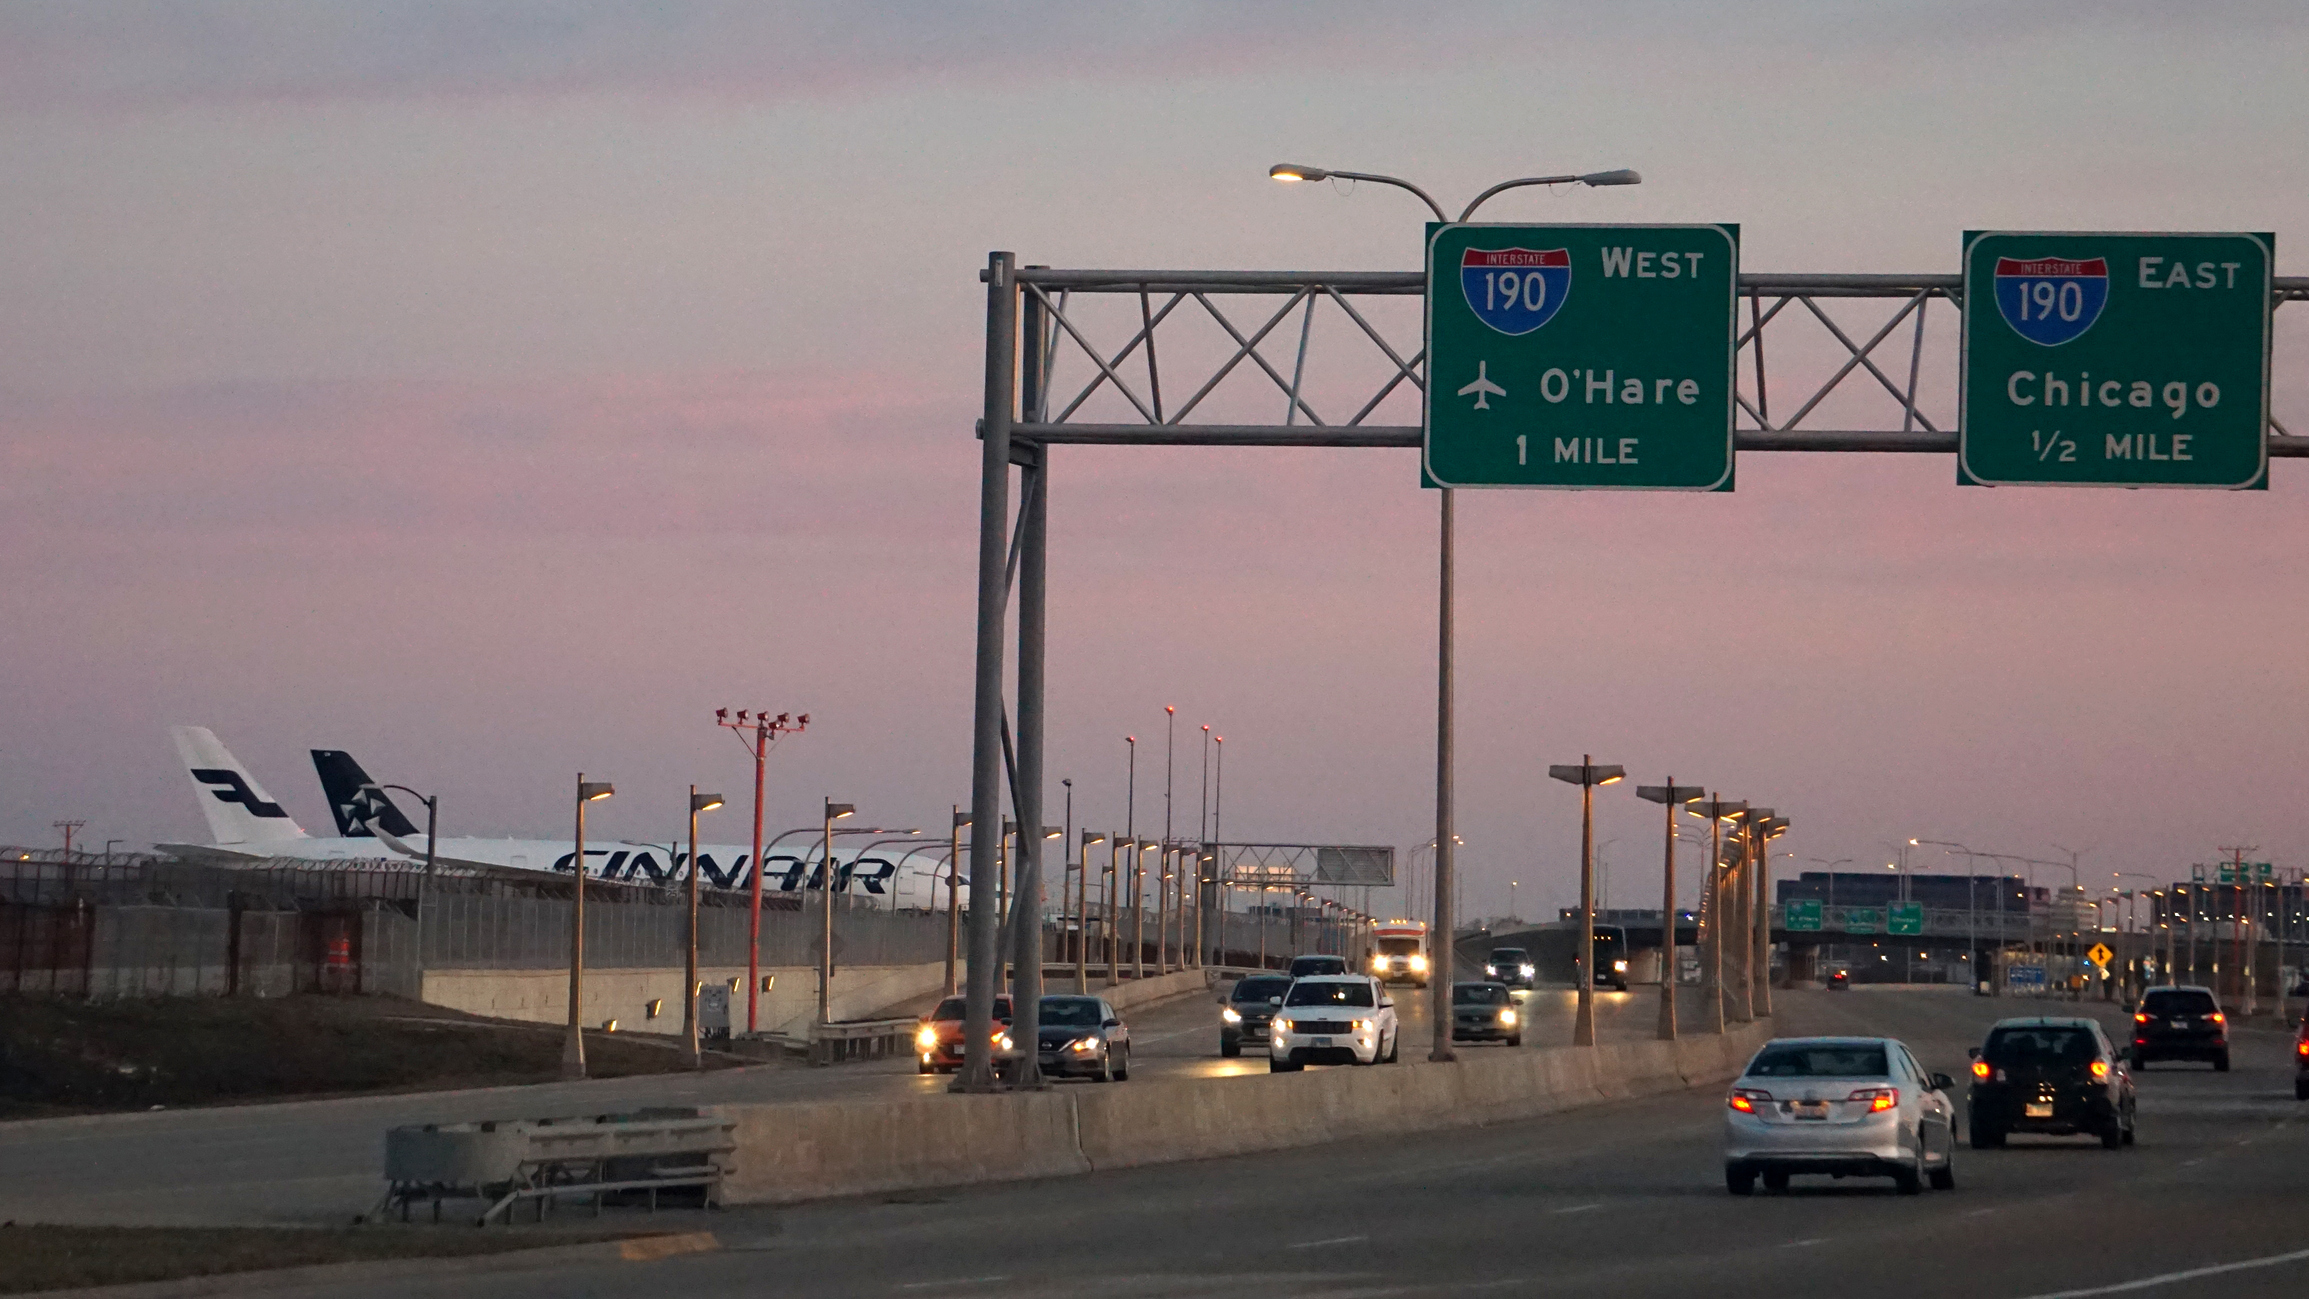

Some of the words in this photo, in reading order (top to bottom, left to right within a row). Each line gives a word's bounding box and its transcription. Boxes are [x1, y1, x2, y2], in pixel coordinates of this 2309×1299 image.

[1486, 253, 1546, 265] INTERSTATE
[1601, 247, 1704, 278] WEST
[2020, 263, 2082, 275] INTERSTATE
[2139, 257, 2241, 289] EAST
[1485, 272, 1546, 312] 190
[2019, 281, 2083, 322] 190
[1540, 368, 1700, 405] O'Hare
[2007, 371, 2221, 419] Chicago
[1516, 435, 1527, 466] 1
[1554, 437, 1639, 464] MILE
[2105, 434, 2193, 460] MILE
